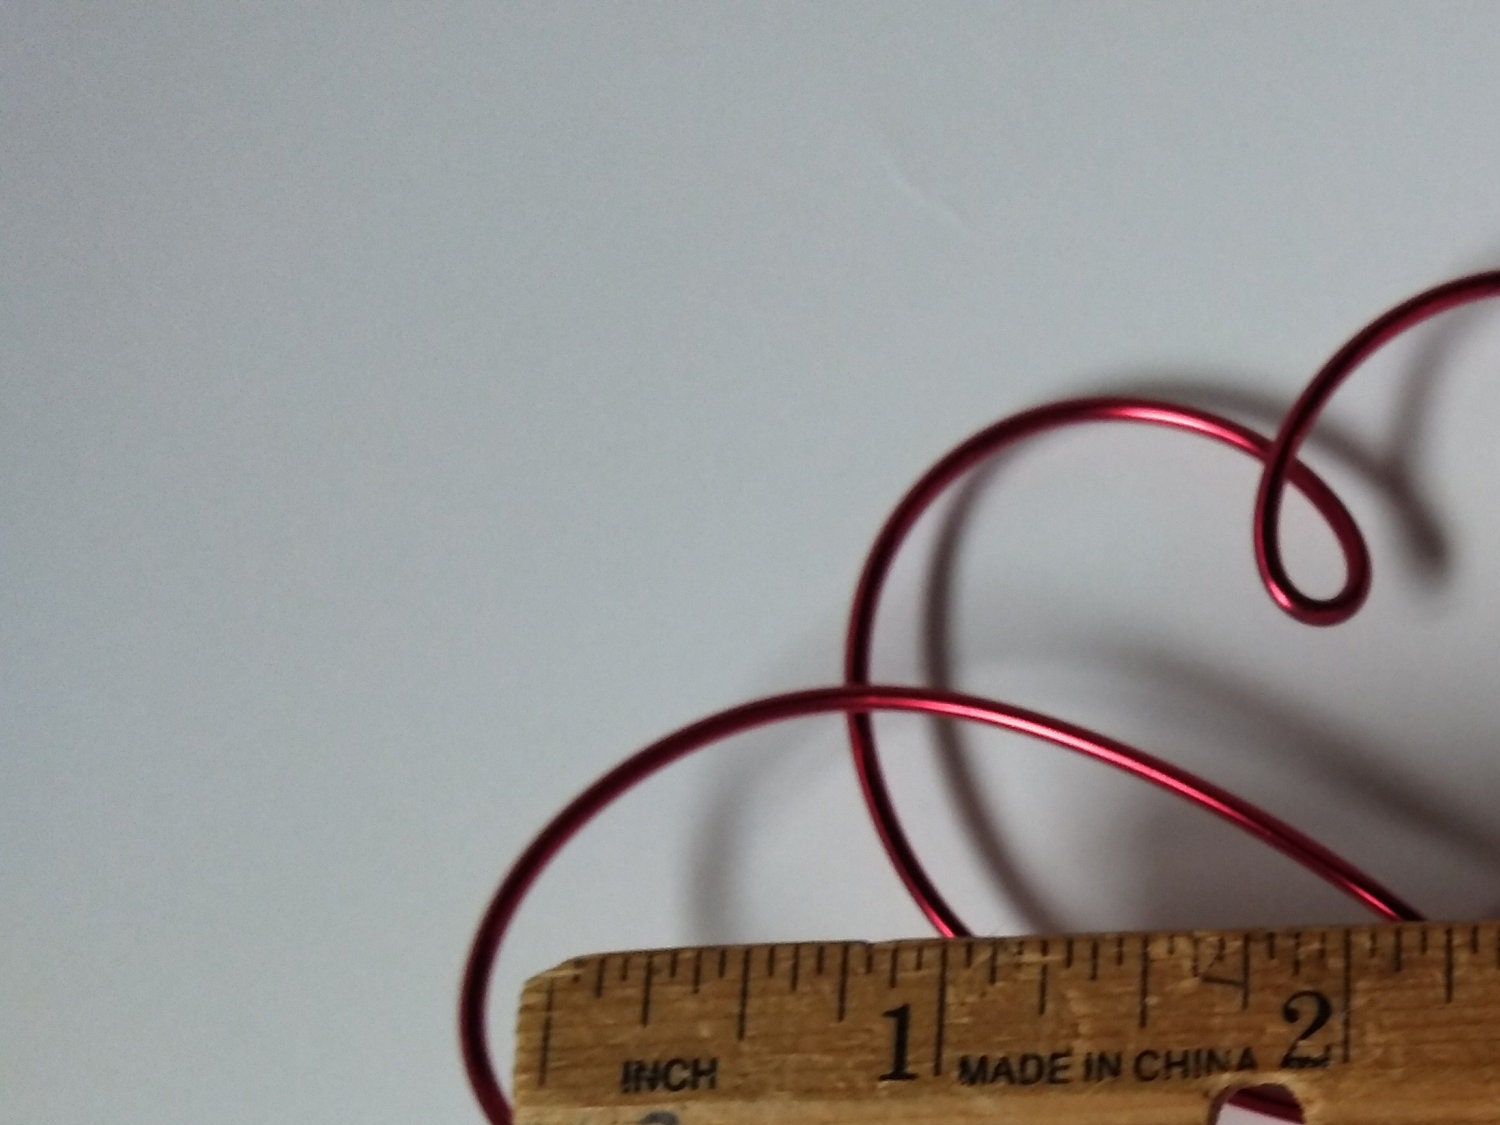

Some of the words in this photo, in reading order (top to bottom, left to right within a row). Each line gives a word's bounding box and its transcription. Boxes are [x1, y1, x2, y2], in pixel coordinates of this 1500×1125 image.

[880, 1004, 918, 1082] 1
[1281, 991, 1330, 1068] 2
[620, 1056, 719, 1093] INCH
[957, 1052, 1069, 1086] MADE
[1083, 1050, 1121, 1082] IN
[1134, 1045, 1258, 1082] CHINA
